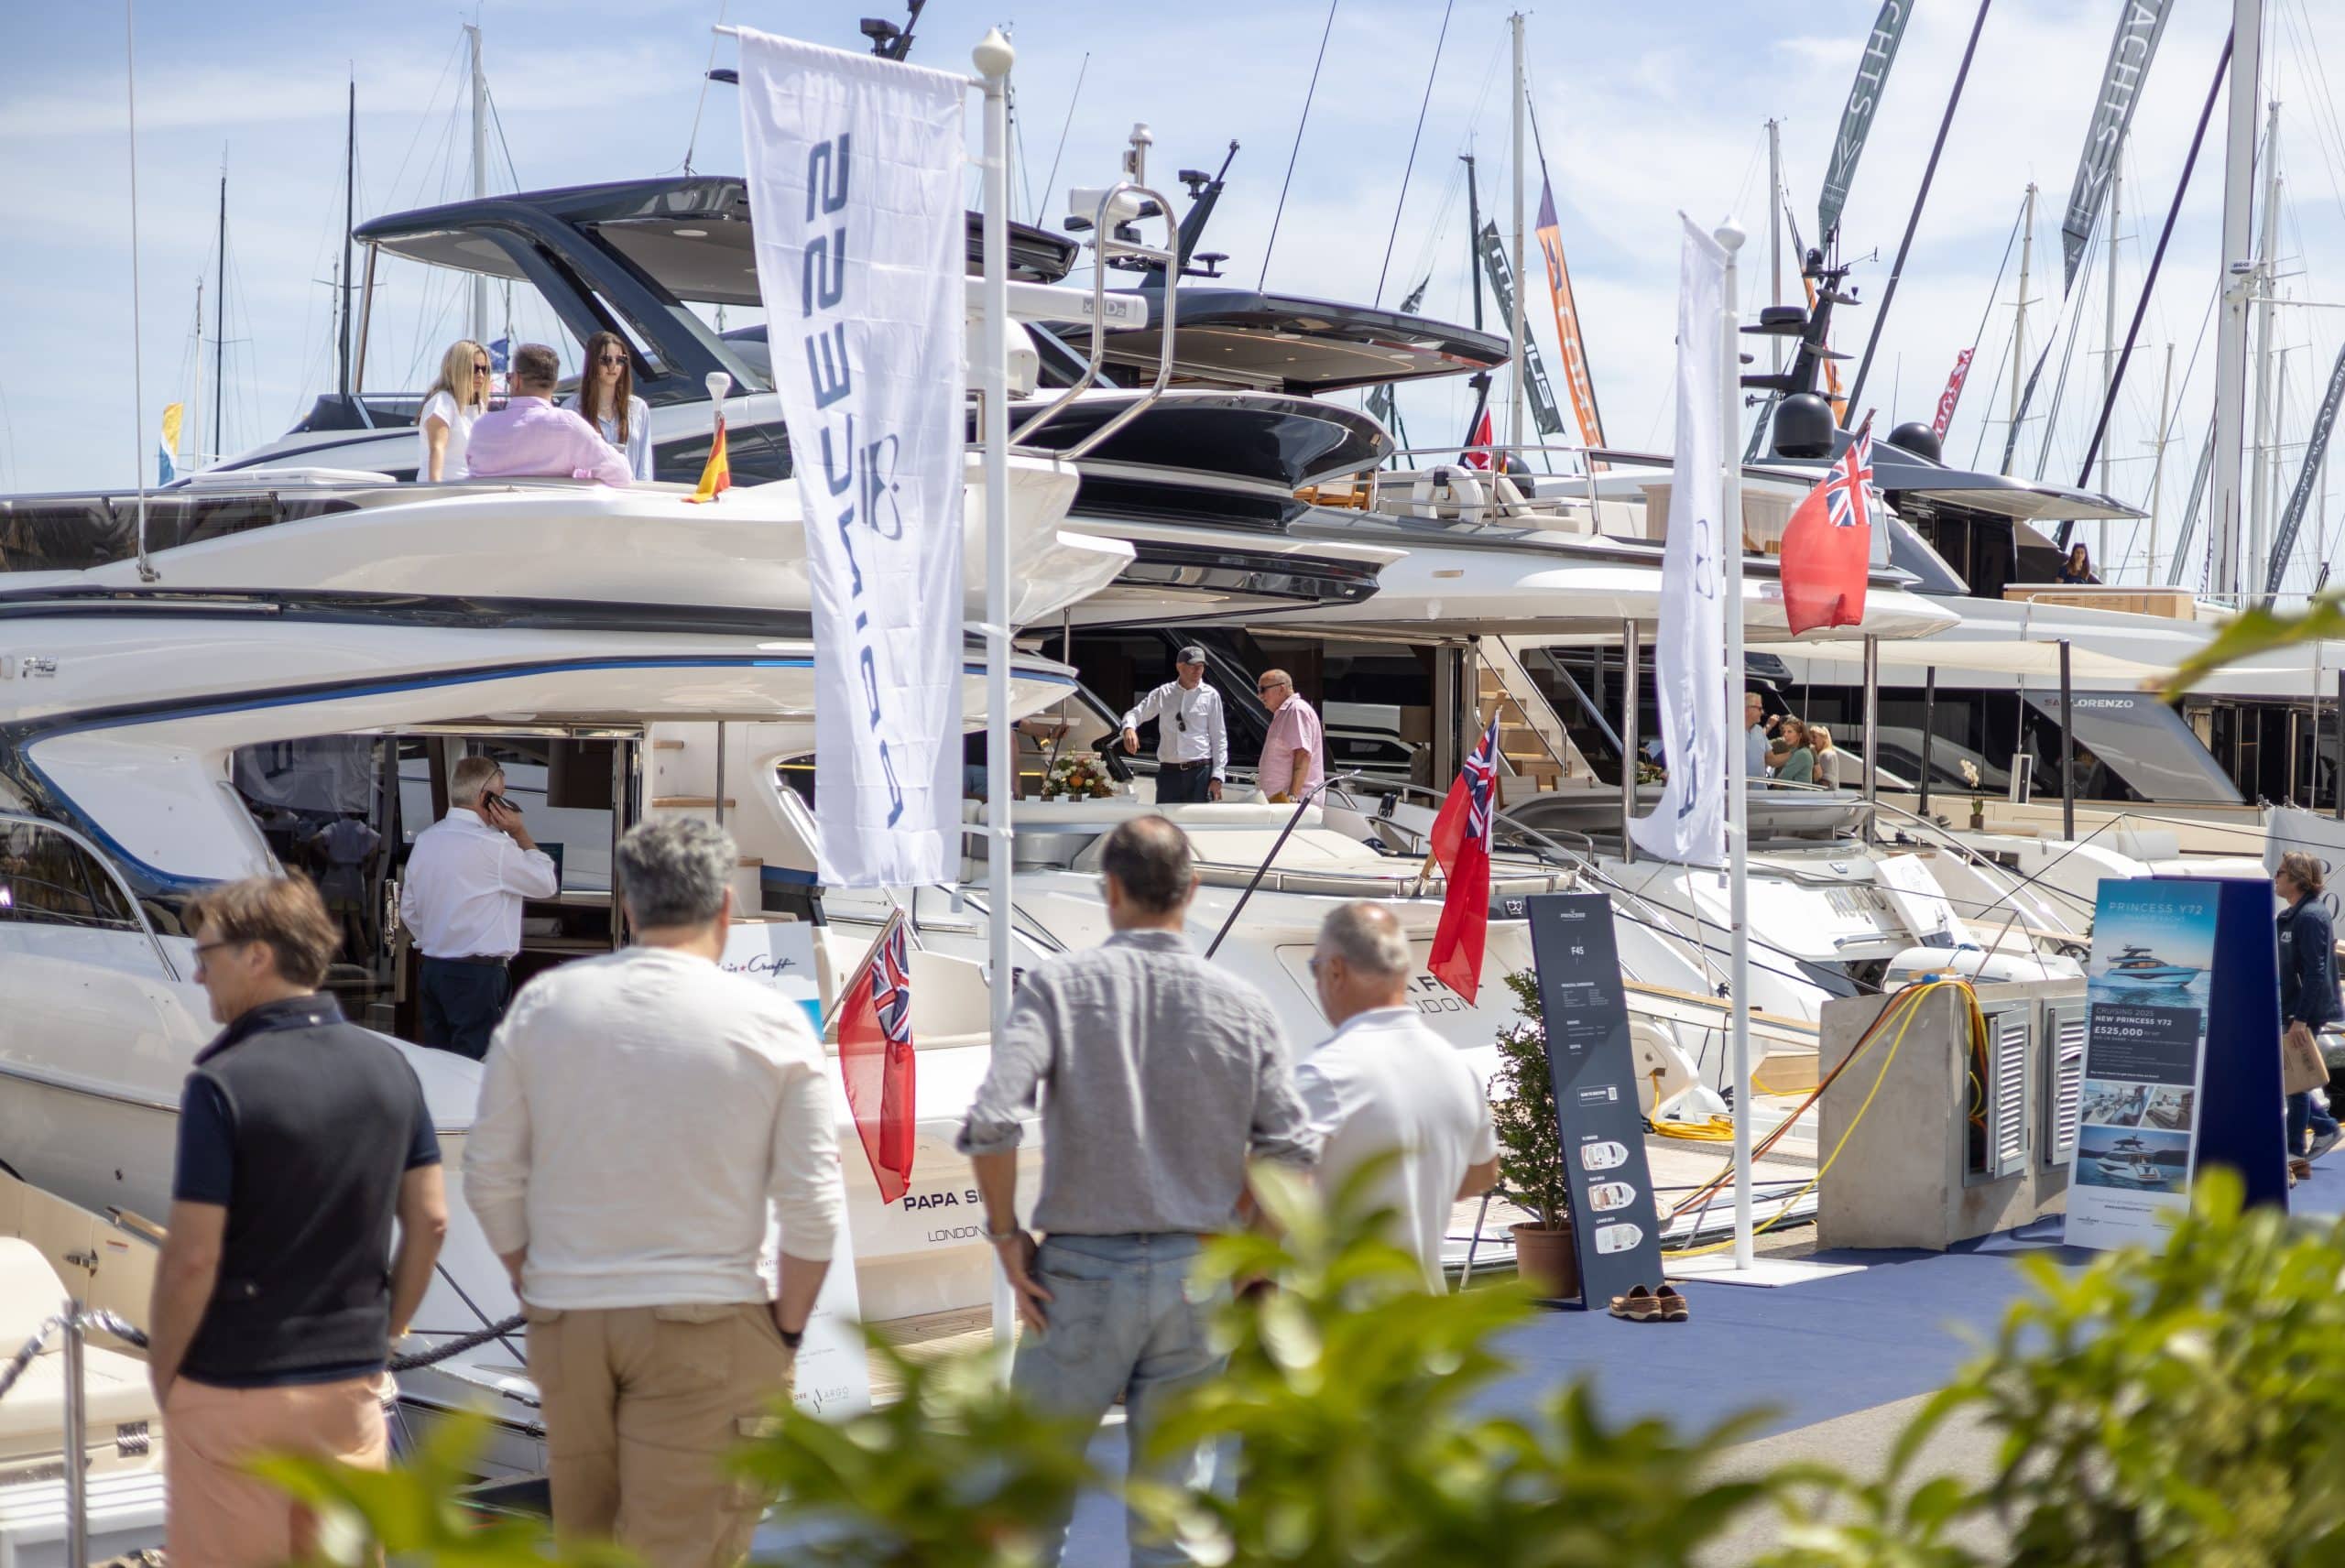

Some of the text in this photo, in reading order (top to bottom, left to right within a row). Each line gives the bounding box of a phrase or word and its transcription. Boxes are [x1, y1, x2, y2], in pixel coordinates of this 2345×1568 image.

[2097, 0, 2163, 149] ACHTS
[1084, 300, 1126, 316] xD2
[2045, 699, 2134, 708] SALORENZO
[2110, 902, 2204, 915] PRINCESS Y72
[1571, 946, 1584, 955] F45
[748, 953, 796, 977] Craft
[2116, 1017, 2154, 1025] PRINCESS
[2094, 1026, 2143, 1036] £525,000
[903, 1192, 959, 1211] PAPA
[928, 1225, 987, 1242] LONDON
